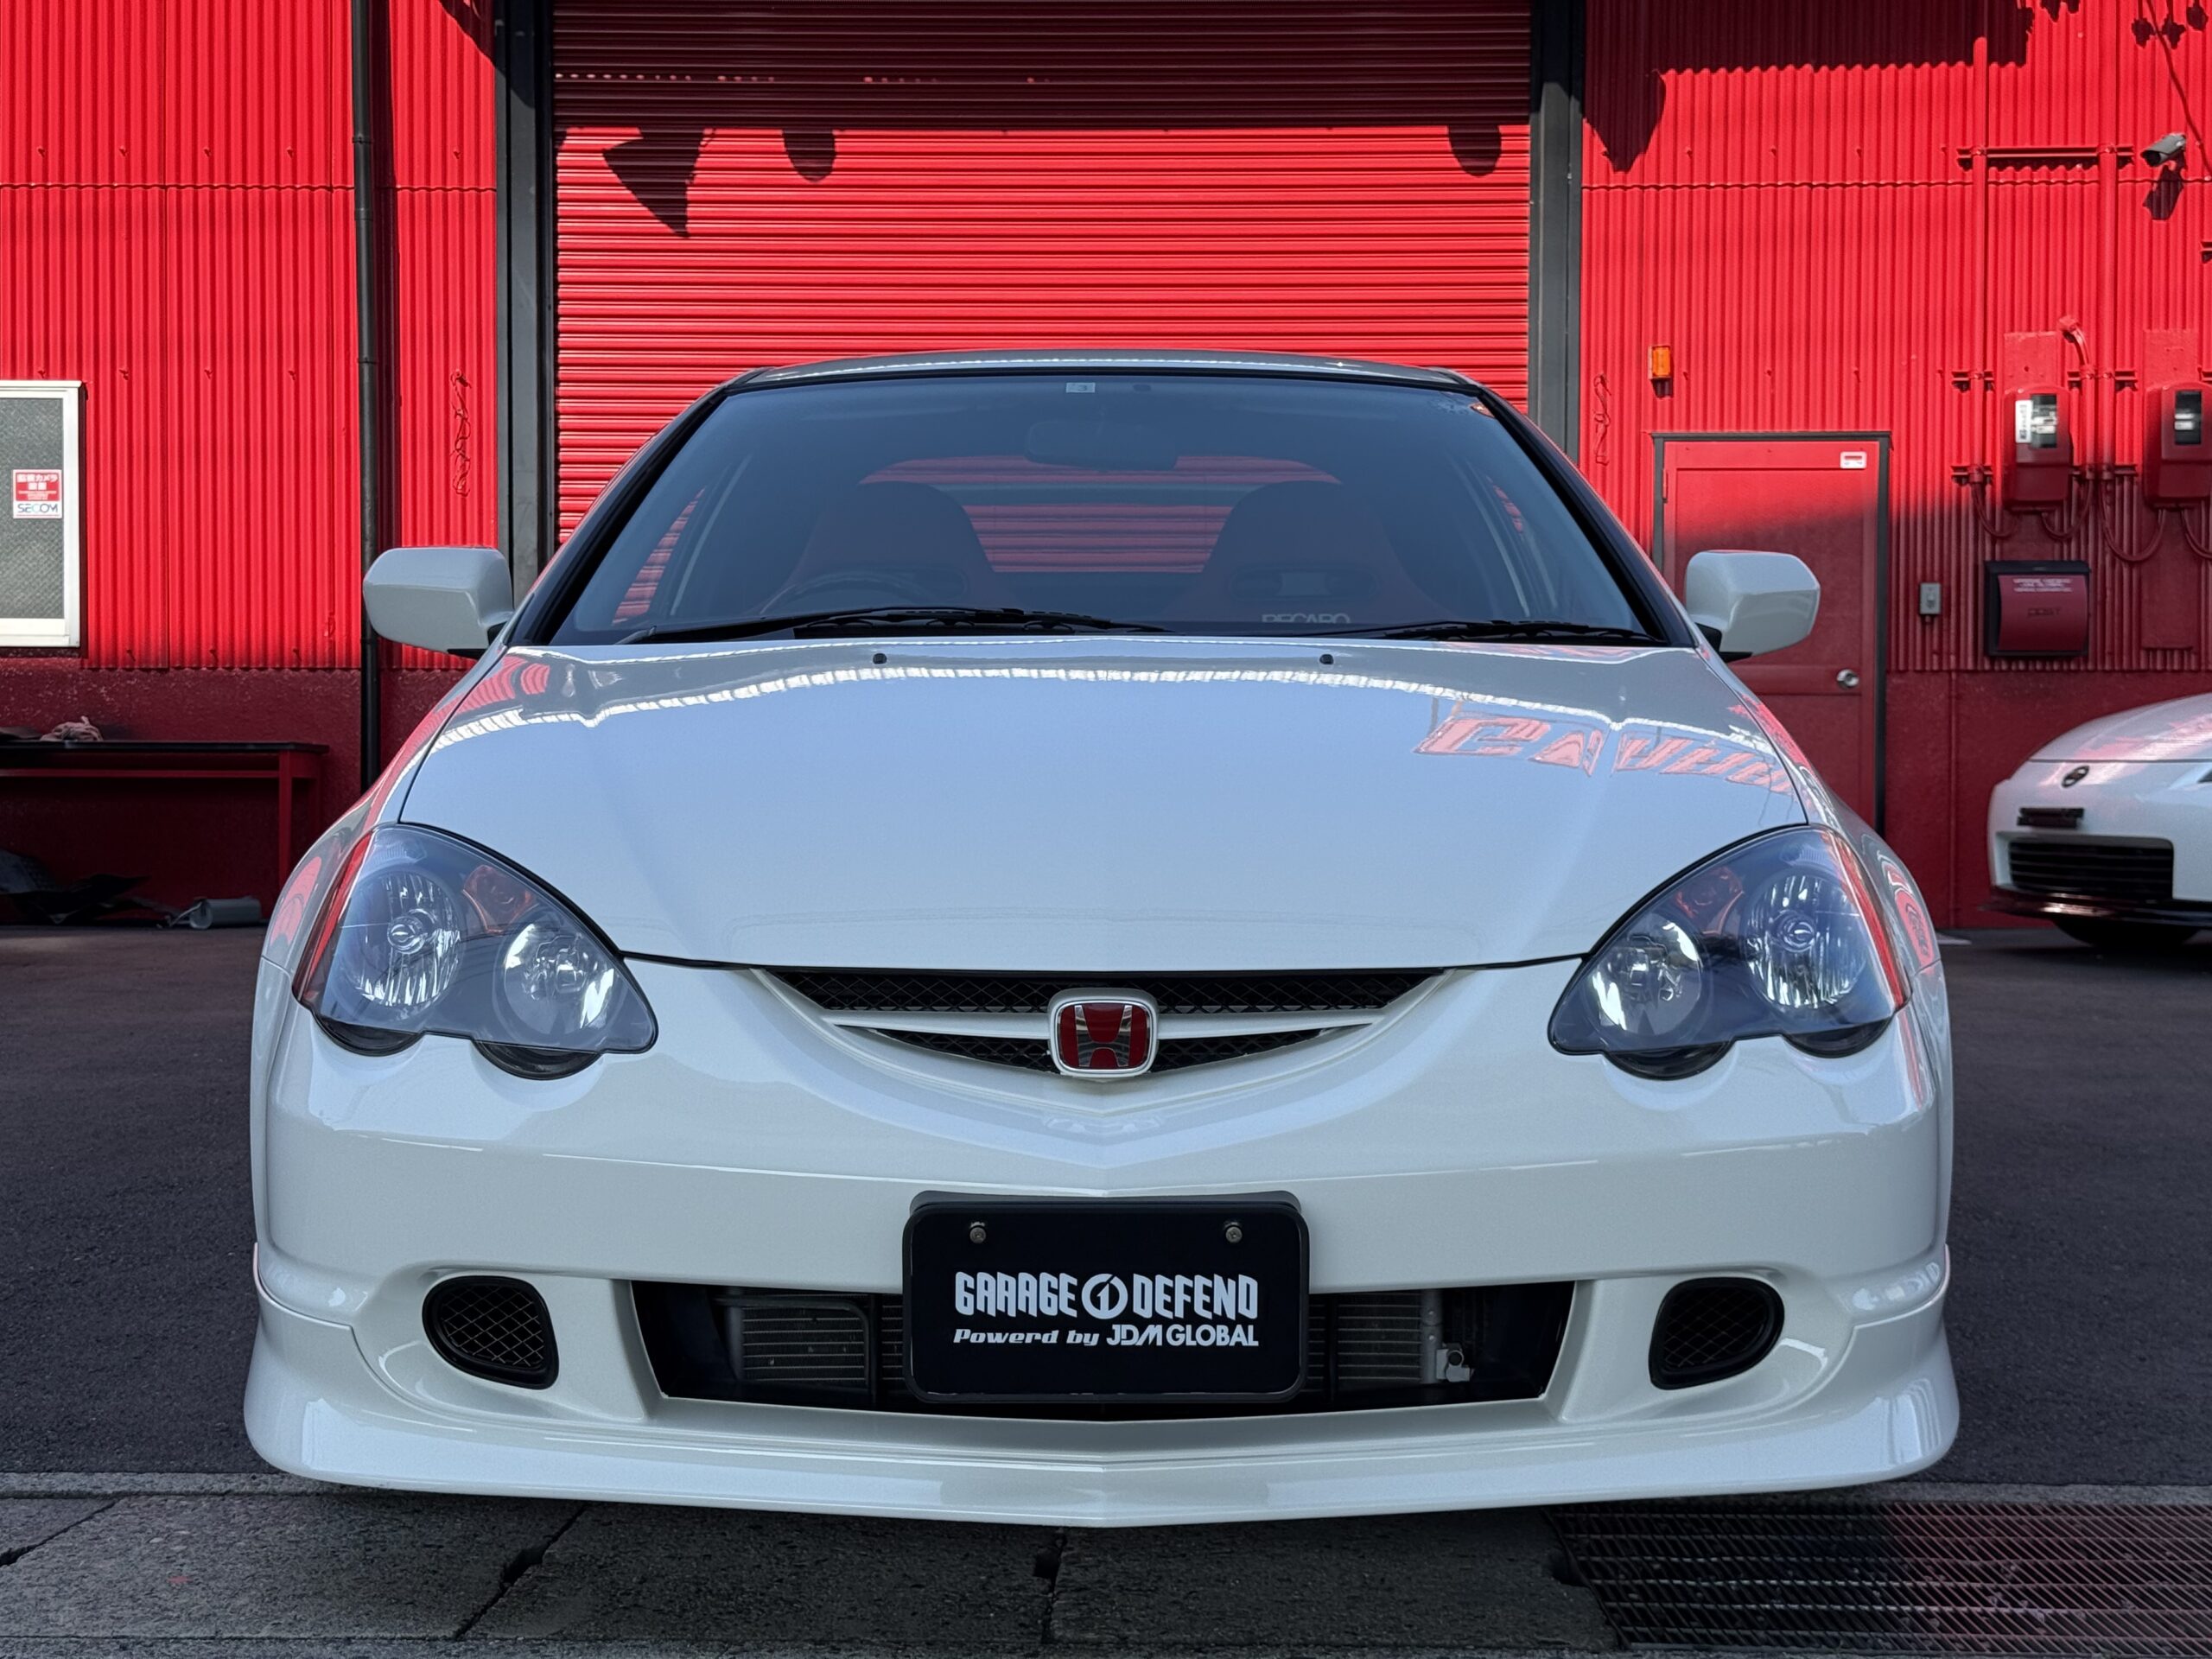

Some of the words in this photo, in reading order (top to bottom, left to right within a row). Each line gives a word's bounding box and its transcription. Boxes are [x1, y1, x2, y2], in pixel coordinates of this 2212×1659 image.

[17, 503, 59, 513] SECOM
[955, 1271, 1077, 1318] GARAGE
[1133, 1273, 1258, 1320] DEFEND
[953, 1328, 1059, 1344] Powerd
[1066, 1329, 1100, 1346] by
[1106, 1324, 1163, 1346] JDM
[1166, 1324, 1259, 1346] GLOBAL
